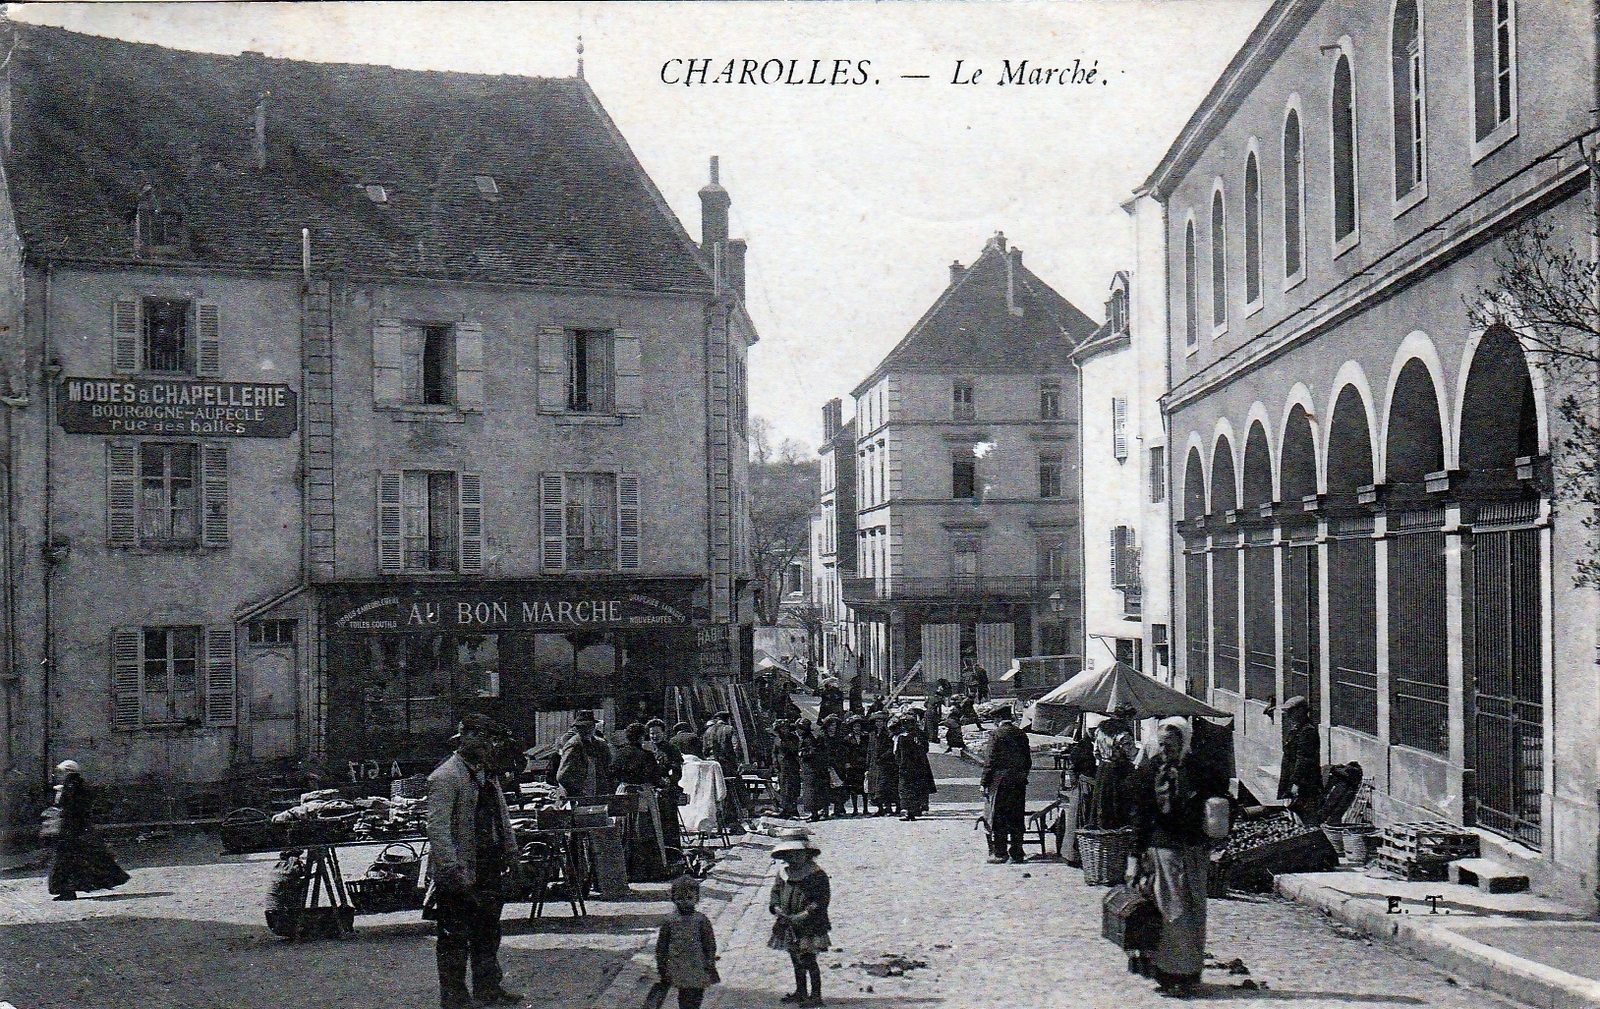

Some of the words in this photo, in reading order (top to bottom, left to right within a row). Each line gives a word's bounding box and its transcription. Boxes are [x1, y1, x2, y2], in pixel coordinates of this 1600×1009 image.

[68, 381, 135, 402] MODES
[138, 388, 150, 403] &
[152, 384, 285, 407] CHAPELLERIE
[112, 420, 148, 431] rue
[153, 421, 184, 431] des
[408, 602, 440, 625] AU
[457, 602, 508, 624] BON
[521, 600, 622, 626] MARCHE
